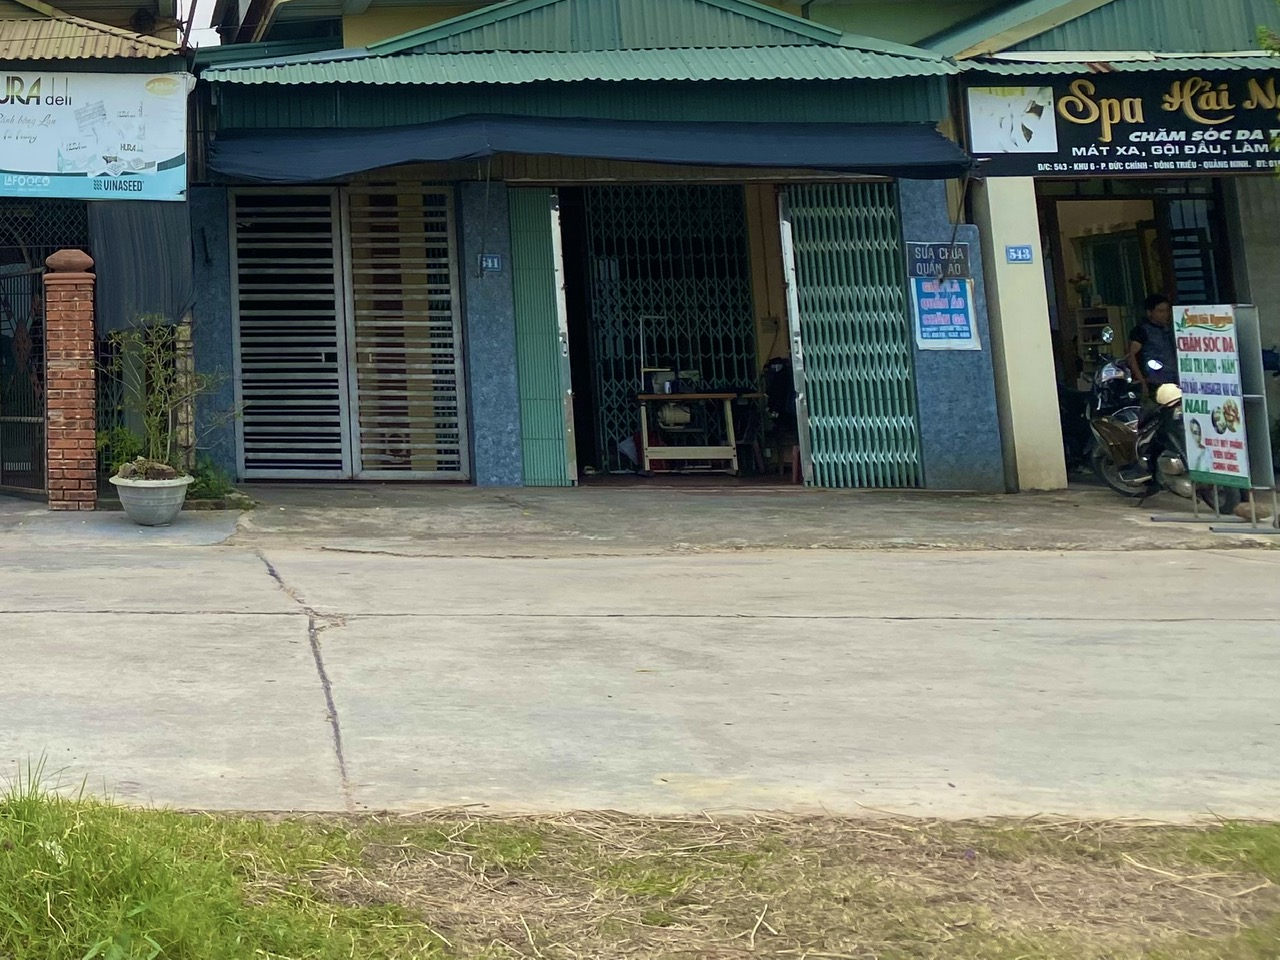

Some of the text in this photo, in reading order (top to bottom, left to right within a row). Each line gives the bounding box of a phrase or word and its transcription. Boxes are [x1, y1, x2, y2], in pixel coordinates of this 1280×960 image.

[45, 76, 72, 106] deli
[1057, 78, 1146, 143] Spa
[1161, 76, 1237, 125] Hải
[1128, 127, 1186, 142] CHĂM
[1191, 127, 1233, 141] SÓC
[1235, 129, 1264, 140] DA
[1071, 143, 1110, 156] MÁT
[1116, 146, 1147, 157] XA,
[1184, 140, 1227, 155] ĐẦU,
[1232, 141, 1269, 153] LÀM
[1053, 163, 1068, 171] 543
[1073, 162, 1089, 171] KHU
[103, 179, 143, 192] VINASEED
[1009, 248, 1030, 260] 543
[1177, 332, 1235, 352] CHĂM SÓC DA
[1184, 399, 1211, 414] NAIL
